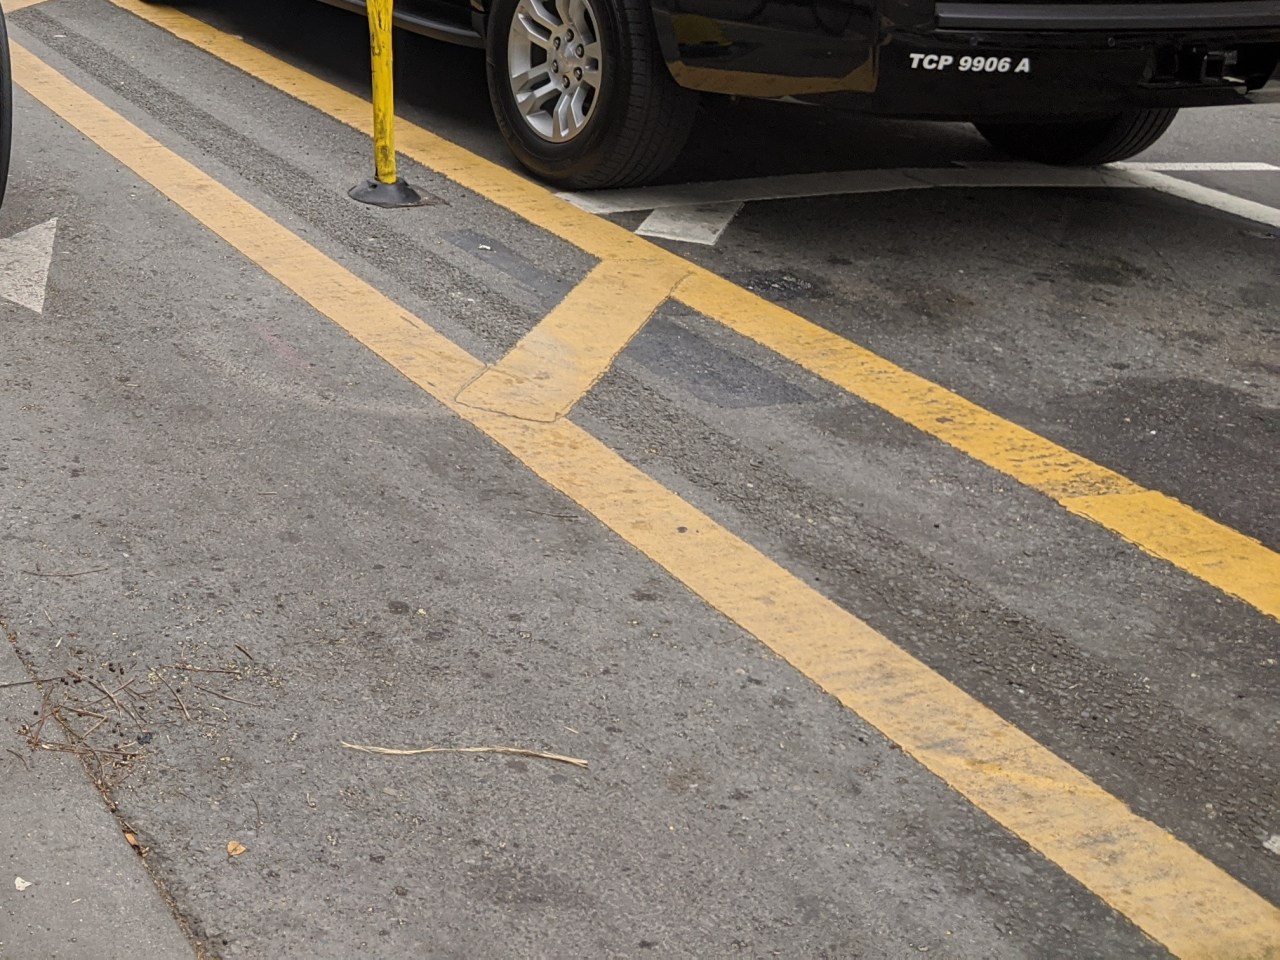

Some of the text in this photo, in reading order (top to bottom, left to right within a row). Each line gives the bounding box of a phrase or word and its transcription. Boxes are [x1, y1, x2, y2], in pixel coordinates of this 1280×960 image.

[909, 53, 1030, 73] TCP 9906 A
